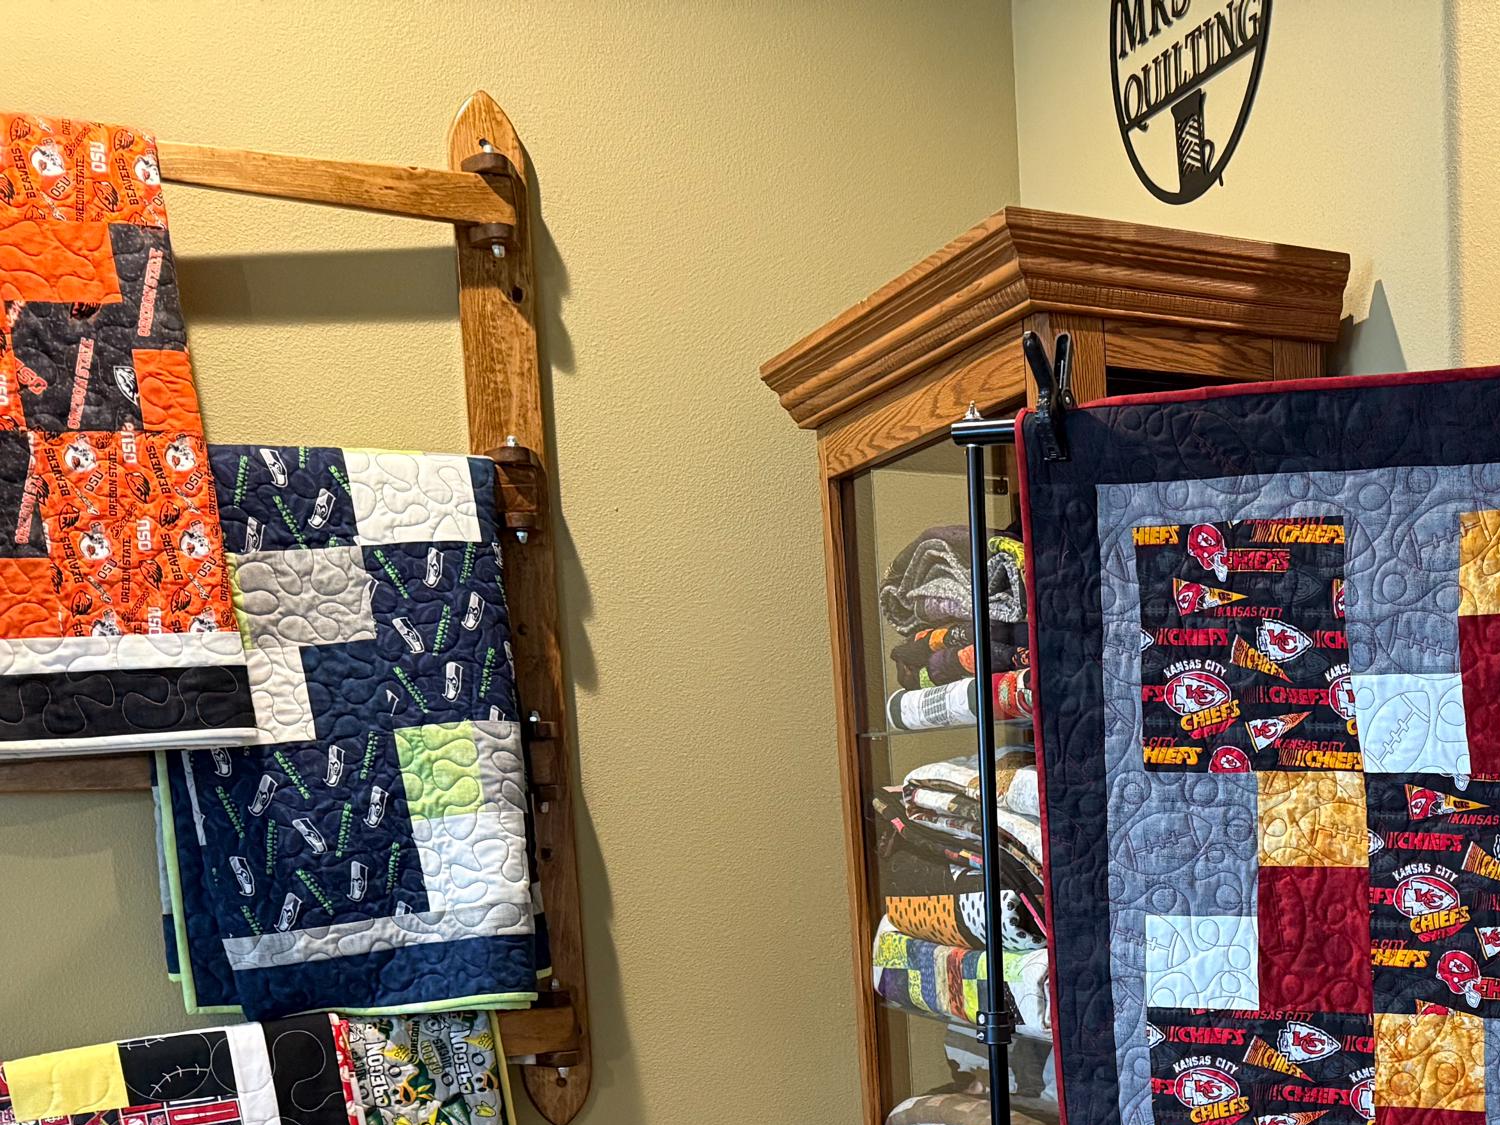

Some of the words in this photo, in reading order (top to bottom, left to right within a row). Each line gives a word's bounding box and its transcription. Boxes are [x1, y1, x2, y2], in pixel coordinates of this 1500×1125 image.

[1124, 0, 1260, 132] QUILTING
[90, 141, 106, 173] OSU
[12, 147, 36, 199] BEAVERS
[51, 176, 71, 197] OSU
[115, 158, 139, 205] BEAVERS
[45, 447, 70, 496] BEAVERS
[84, 472, 104, 492] OSU
[147, 446, 171, 494] BEAVERS
[185, 472, 203, 491] OSU
[137, 519, 151, 552] OSU
[62, 536, 83, 584] BEAVERS
[98, 559, 118, 579] OSU
[162, 534, 183, 581] BEAVERS
[198, 556, 217, 578] OSU
[1219, 607, 1257, 617] KANSAS
[1260, 607, 1283, 617] CITY
[1169, 628, 1230, 646] CHIEFS
[1164, 660, 1201, 678] KANSAS
[1205, 660, 1227, 677] CITY
[1181, 699, 1241, 730] CHIEFS
[1275, 738, 1319, 750] KANSAS
[1322, 742, 1345, 751] CITY
[273, 751, 311, 800] SEAHAWKS
[215, 785, 245, 839] SEAHAWKS
[1451, 815, 1499, 825] KANSAS
[1398, 832, 1464, 851] CHIEFS
[1392, 863, 1431, 881] KANSAS
[1435, 865, 1458, 882] CITY
[1410, 906, 1471, 933] CHIEFS
[1235, 1011, 1283, 1020] KANSAS
[1286, 1011, 1314, 1022] CITY
[1178, 1027, 1247, 1045] CHIEFS
[365, 1041, 391, 1107] OREGON
[451, 1029, 474, 1094] OREGON
[1173, 1056, 1211, 1073] KANSAS
[1216, 1058, 1239, 1074] CITY
[1190, 1096, 1250, 1123] CHIEFS
